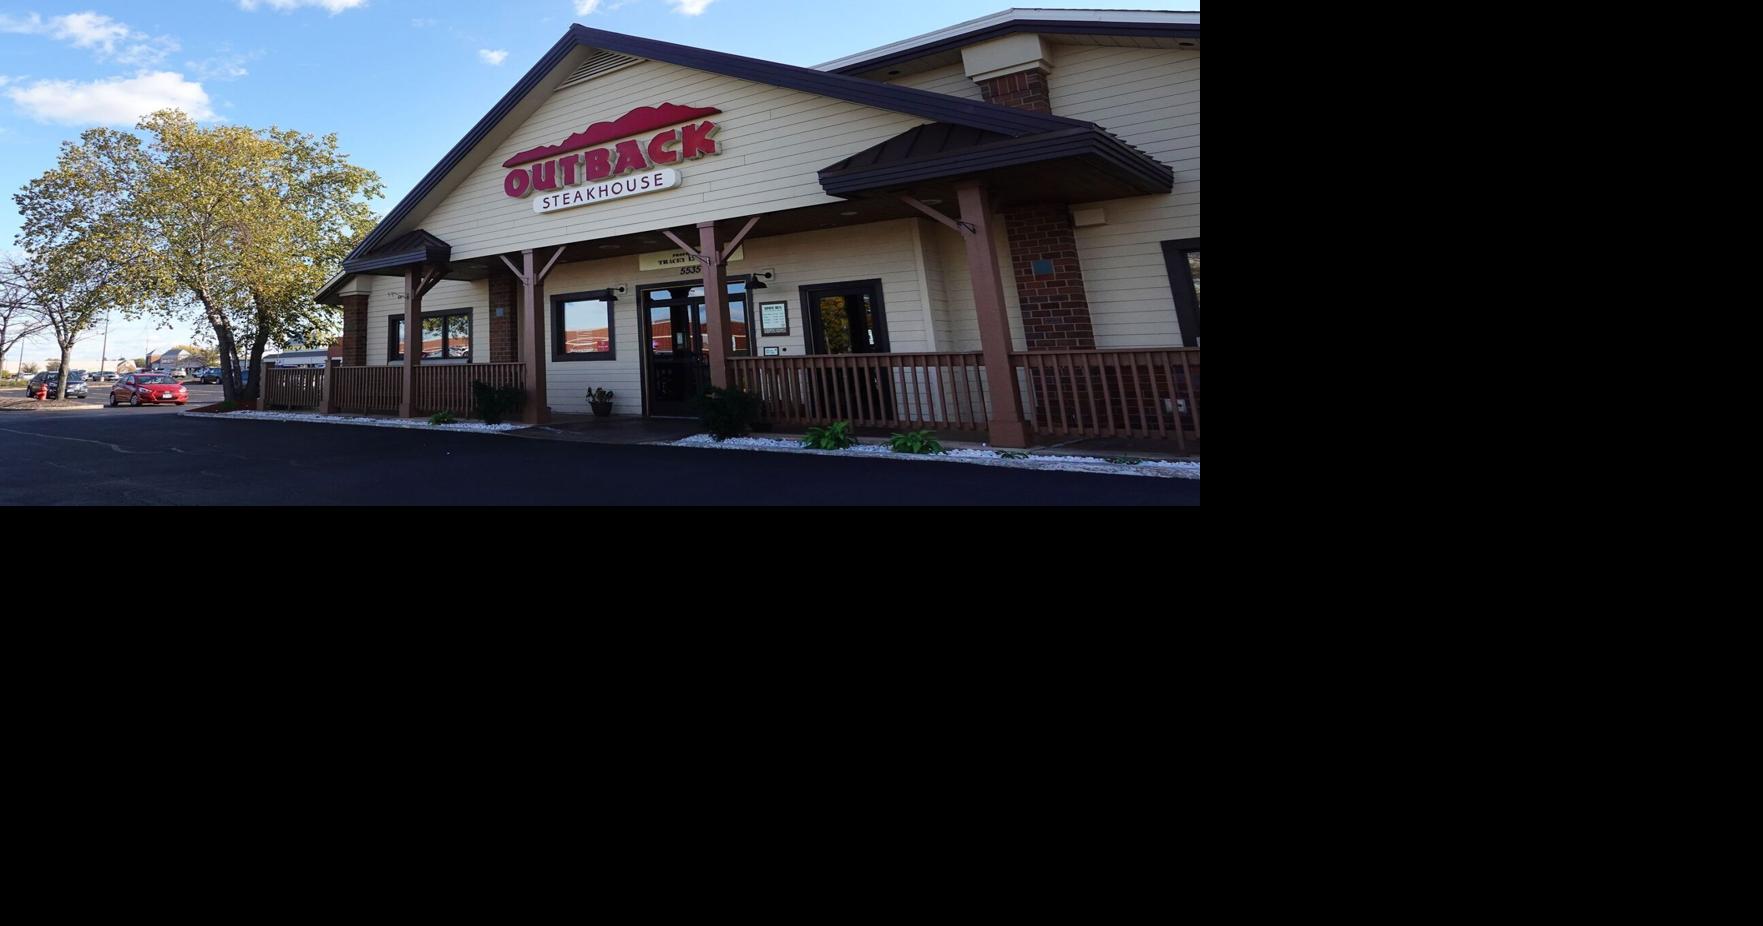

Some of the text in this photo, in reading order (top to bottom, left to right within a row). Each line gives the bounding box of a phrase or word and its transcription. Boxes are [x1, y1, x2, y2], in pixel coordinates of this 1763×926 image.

[504, 121, 720, 198] OUTBACK
[542, 173, 664, 209] STEAKHOUSE
[680, 265, 702, 275] 5535
